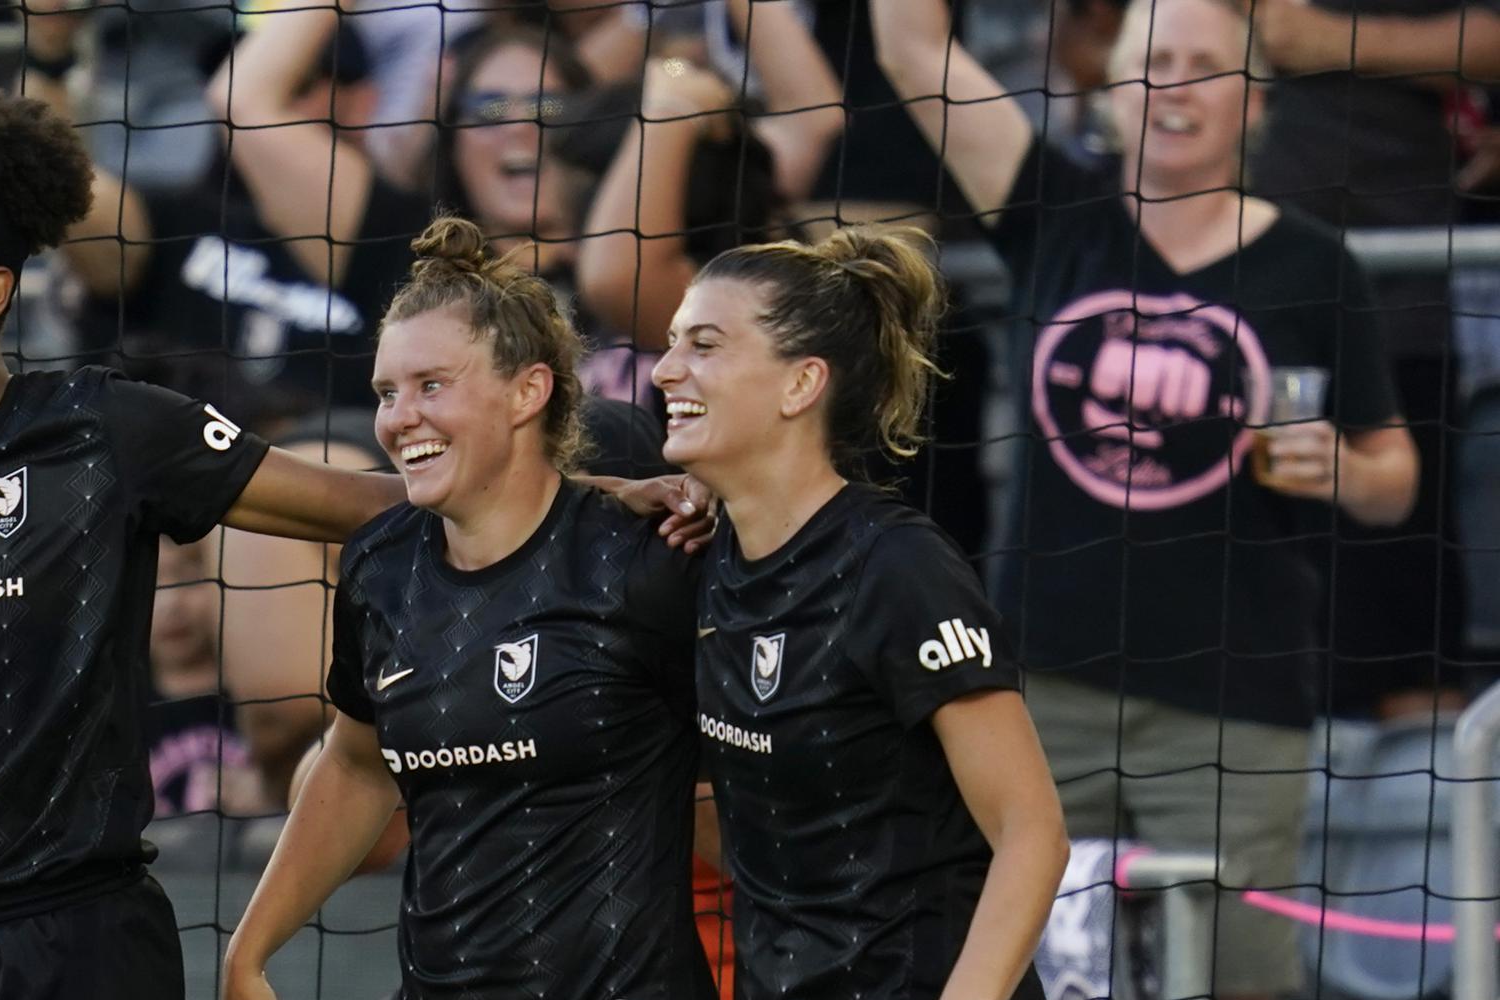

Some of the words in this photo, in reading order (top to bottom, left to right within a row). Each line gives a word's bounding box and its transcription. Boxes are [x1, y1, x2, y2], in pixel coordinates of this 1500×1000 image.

[918, 617, 993, 672] ally
[700, 713, 773, 754] DOORDASH
[404, 738, 538, 771] DOORDASH
